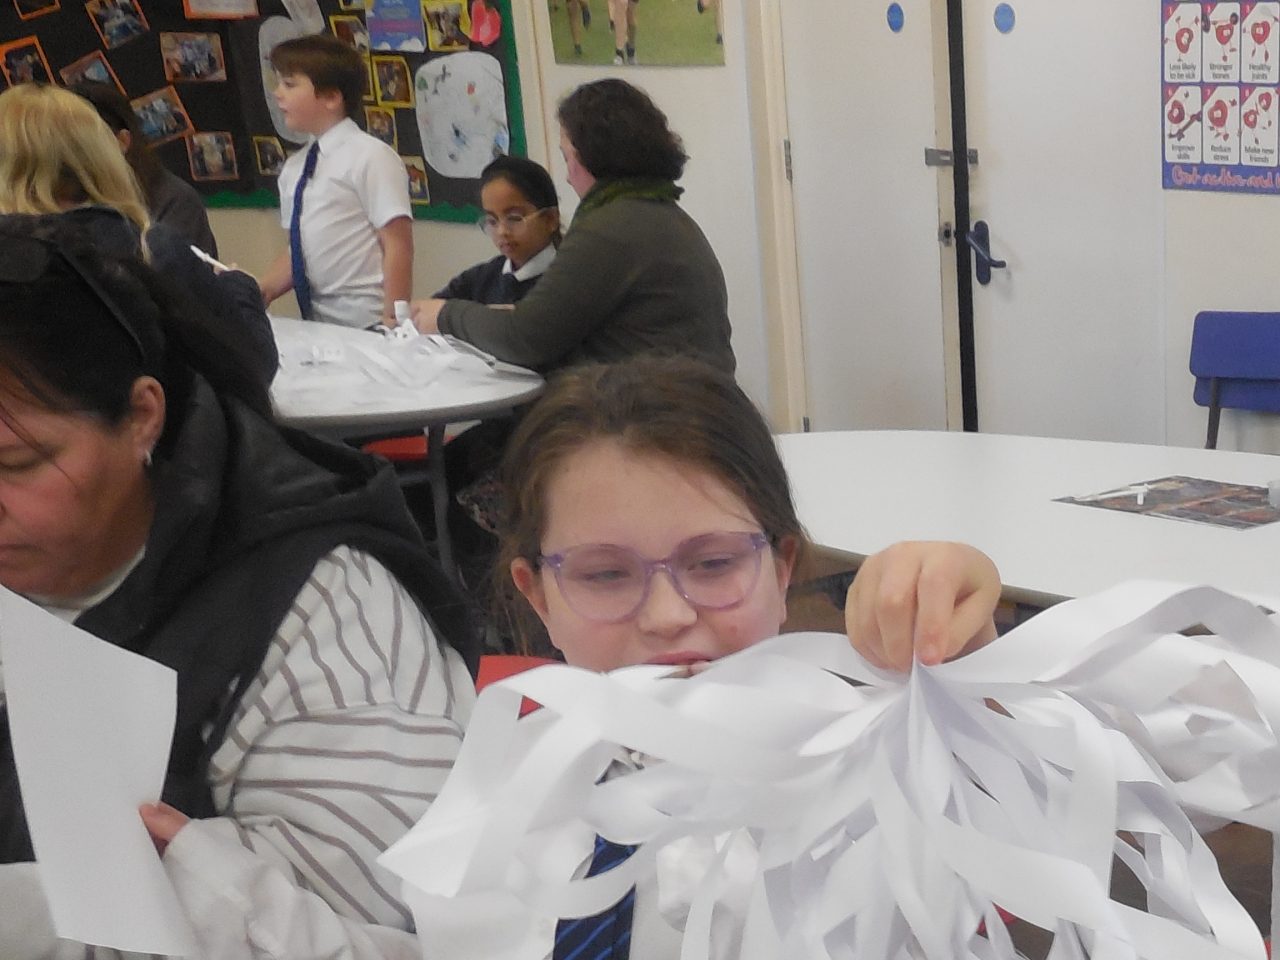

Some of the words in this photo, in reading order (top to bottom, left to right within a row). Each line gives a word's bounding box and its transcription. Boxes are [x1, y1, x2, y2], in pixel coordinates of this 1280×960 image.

[1209, 63, 1233, 72] Stronger
[1249, 63, 1271, 72] Healthy
[1172, 144, 1195, 153] Improve
[1245, 145, 1260, 153] Make
[1172, 165, 1200, 185] Get
[1202, 167, 1246, 186] active
[1247, 172, 1273, 188] and
